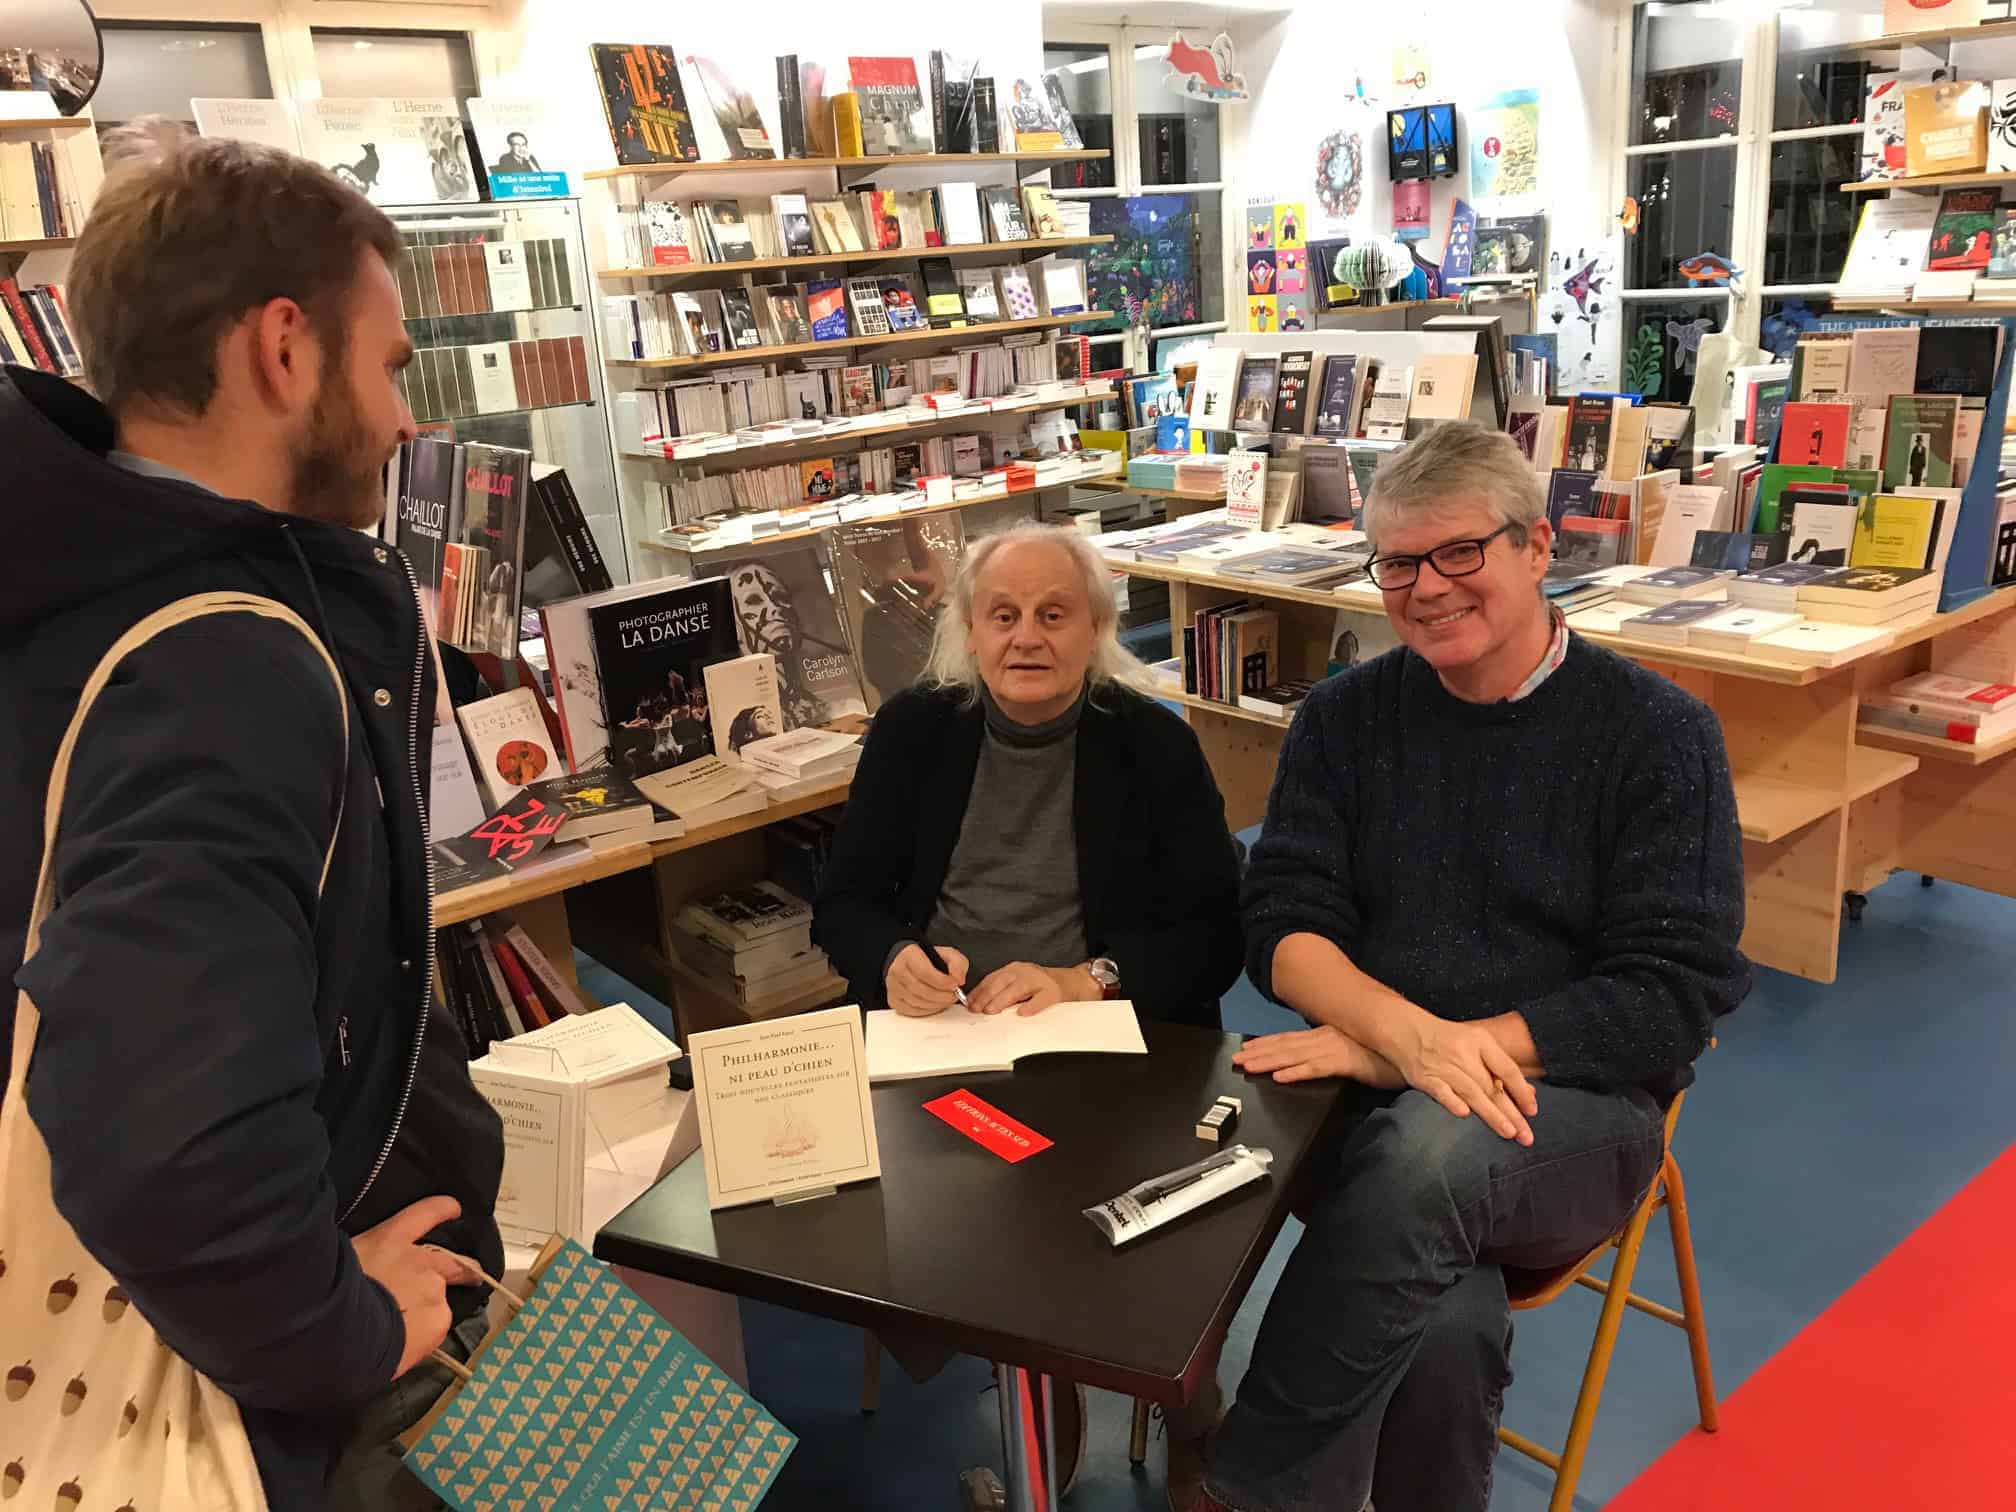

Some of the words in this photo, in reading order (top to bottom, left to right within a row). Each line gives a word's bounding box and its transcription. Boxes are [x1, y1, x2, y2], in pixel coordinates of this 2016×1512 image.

[866, 85, 917, 96] MAGNUM
[464, 466, 514, 497] CHAILLOT
[399, 495, 446, 530] CHAILLOT
[618, 602, 709, 631] PHOTOGRAPHIER
[621, 631, 645, 649] LA
[650, 614, 712, 643] DANSE
[802, 654, 845, 671] Carolyn
[806, 665, 849, 682] Carlson
[729, 1073, 744, 1085] NI
[749, 1069, 779, 1081] PEAU
